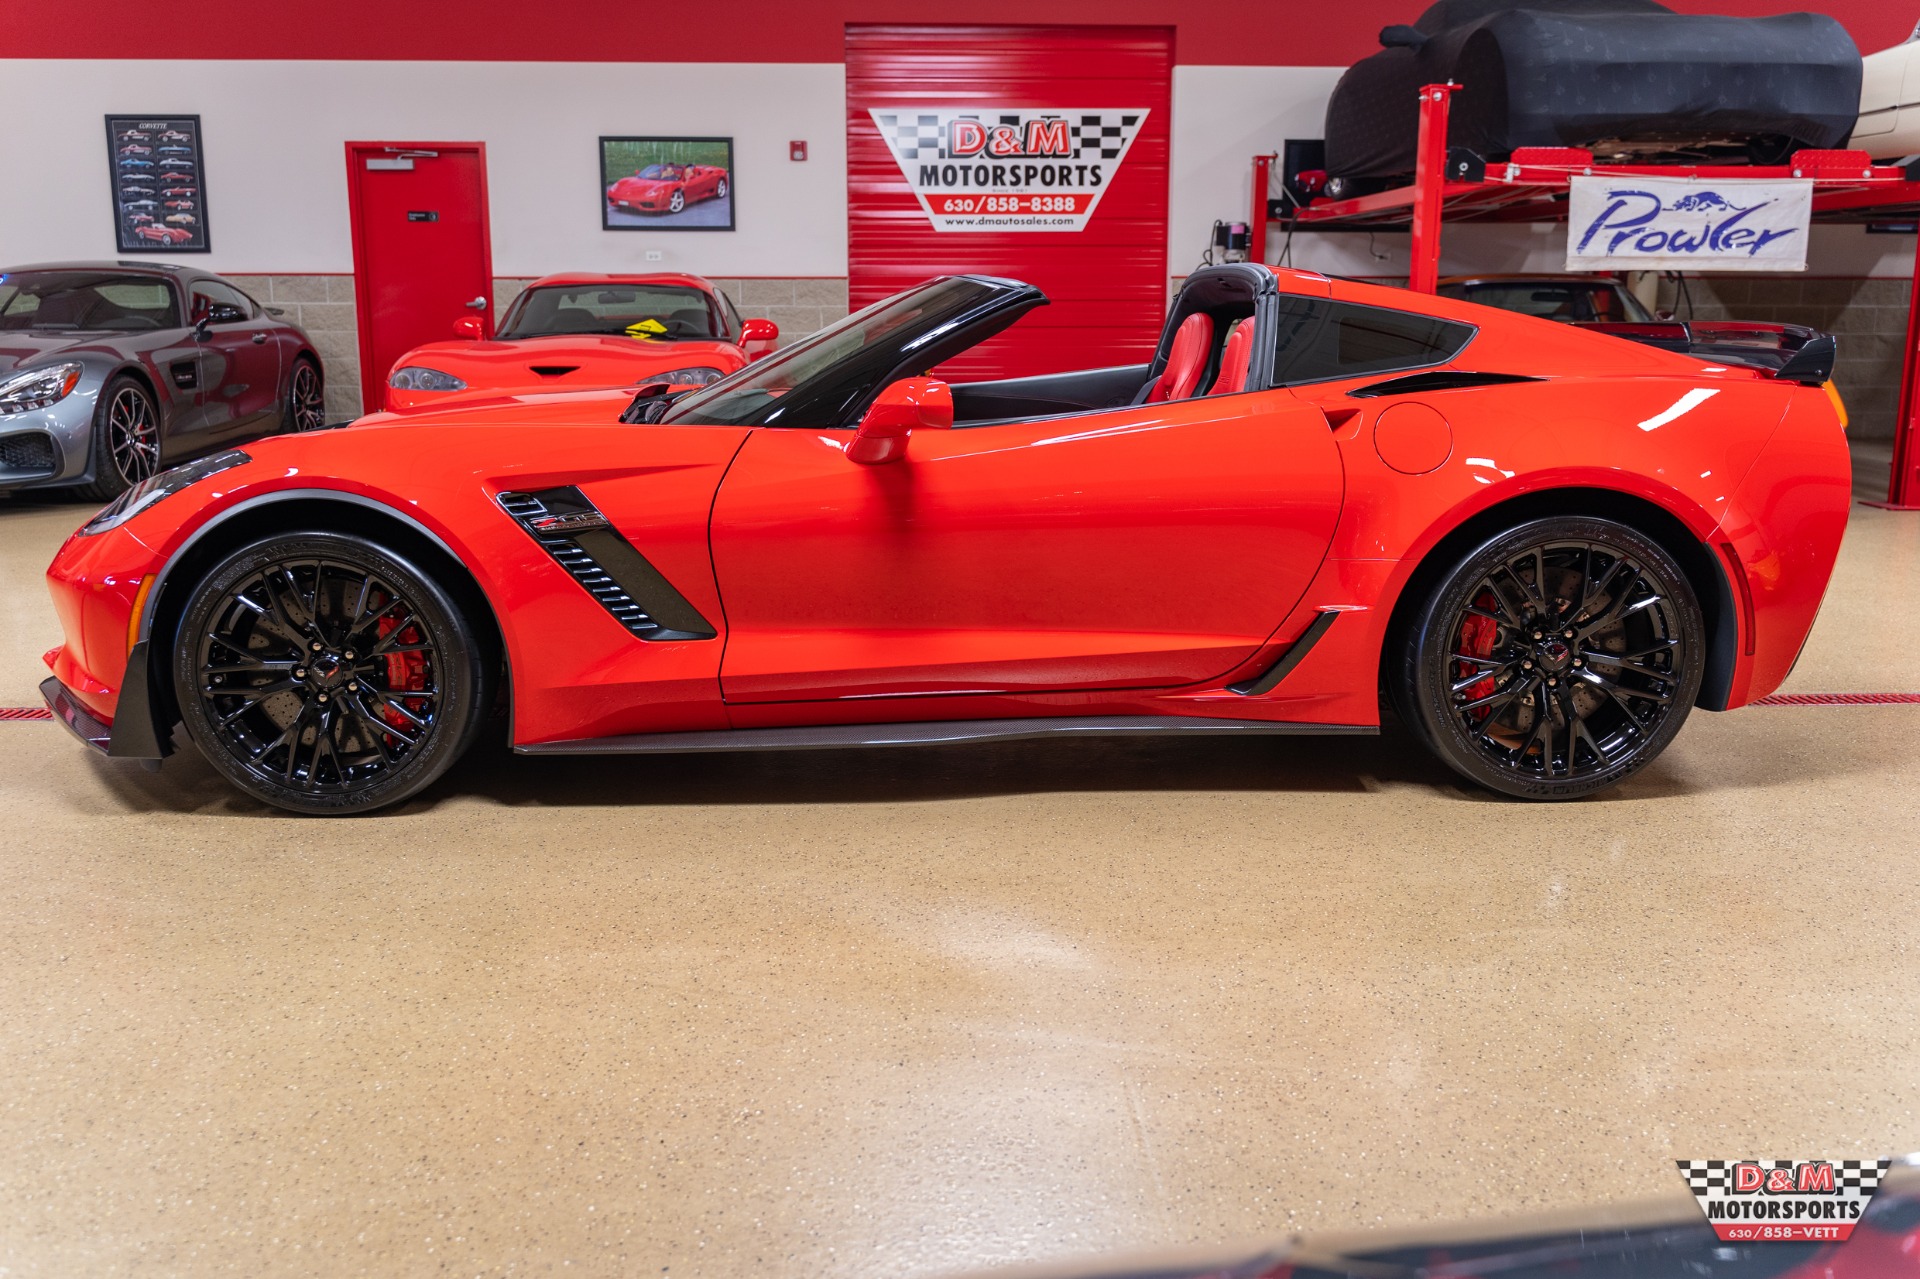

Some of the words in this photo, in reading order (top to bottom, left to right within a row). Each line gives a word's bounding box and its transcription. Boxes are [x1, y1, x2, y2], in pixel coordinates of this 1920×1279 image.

[139, 122, 168, 130] CORVETTE
[950, 120, 1073, 158] D&M
[919, 164, 1102, 187] MOTORSPORTS
[943, 196, 1075, 214] 630/858-8388
[945, 216, 1074, 226] www.dmautosales.com
[1576, 189, 1799, 256] Prowler
